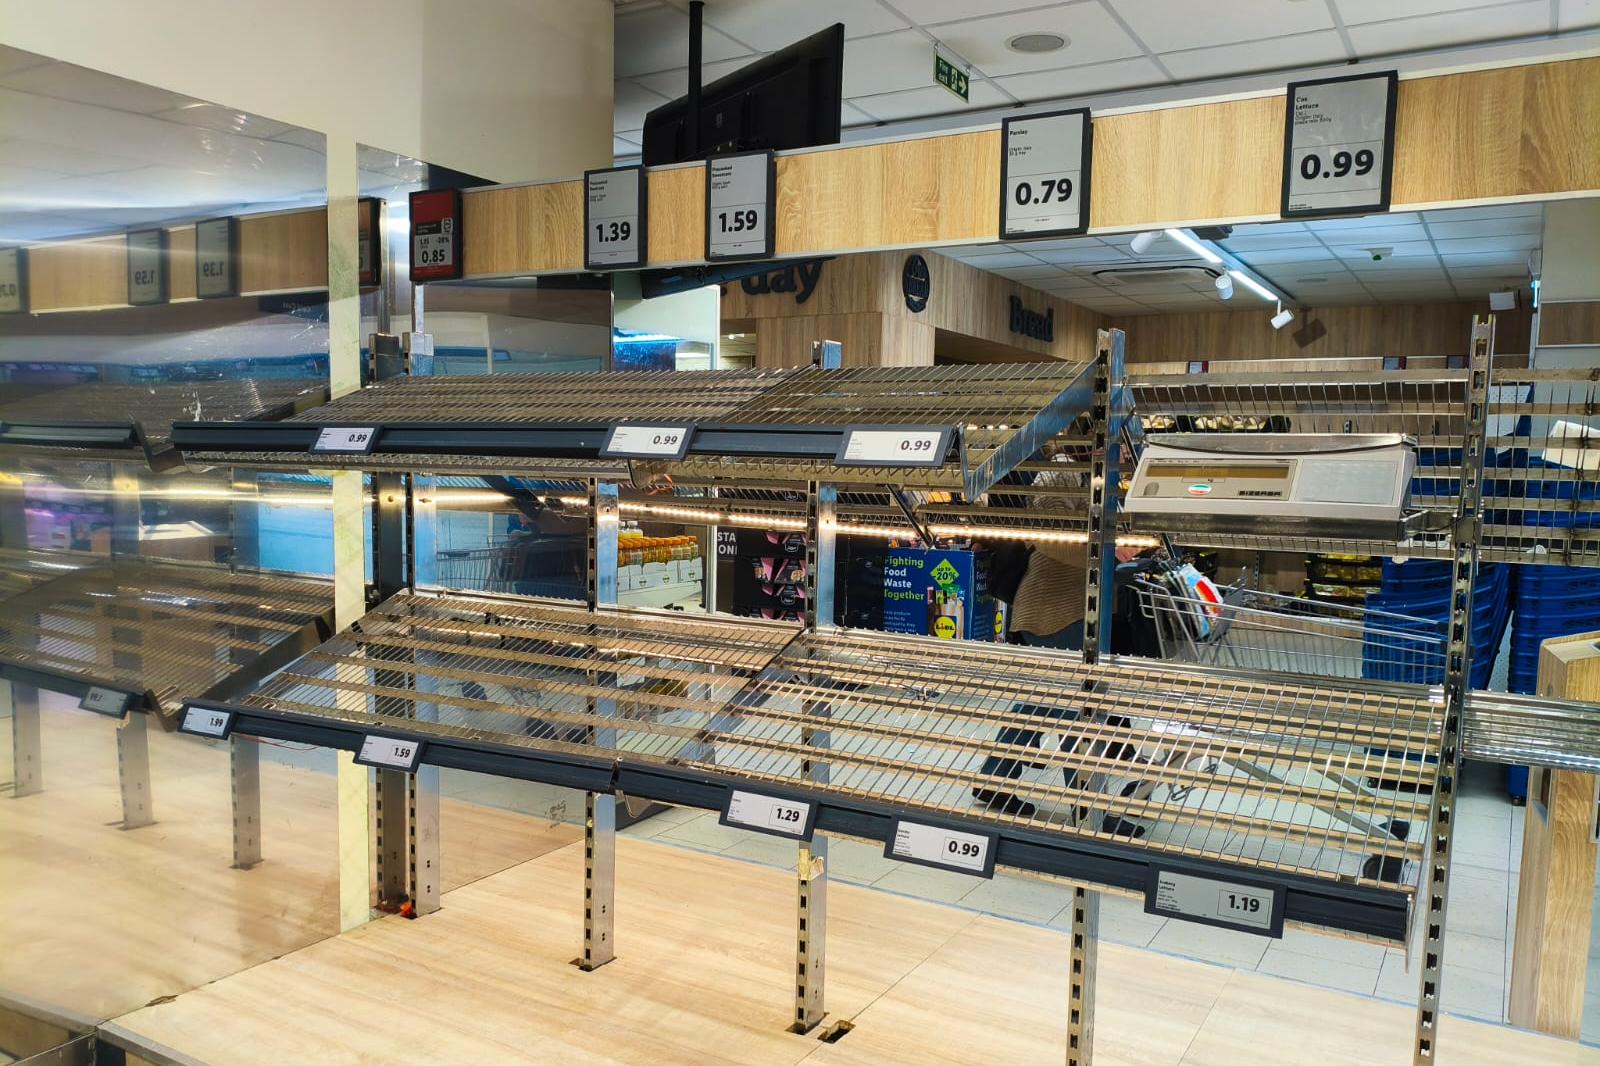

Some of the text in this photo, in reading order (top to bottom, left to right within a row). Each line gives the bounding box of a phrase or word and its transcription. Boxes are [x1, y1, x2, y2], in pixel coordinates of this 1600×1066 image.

[1300, 149, 1374, 180] 0.99
[1015, 178, 1073, 206] 0.79
[718, 209, 758, 232] 1.59
[596, 221, 631, 242] 1.39
[421, 249, 445, 263] 0.85
[1009, 295, 1054, 342] Bread
[348, 434, 368, 443] 0.99
[653, 436, 678, 445] 0.99
[900, 440, 931, 450] 0.99
[884, 567, 907, 577] Food
[883, 579, 912, 589] Waste
[883, 590, 925, 601] Together
[210, 718, 224, 728] 1.99
[394, 748, 410, 758] 1.59
[777, 808, 800, 822] 1.29
[948, 840, 980, 857] 0.99
[1228, 894, 1260, 913] 1.19
